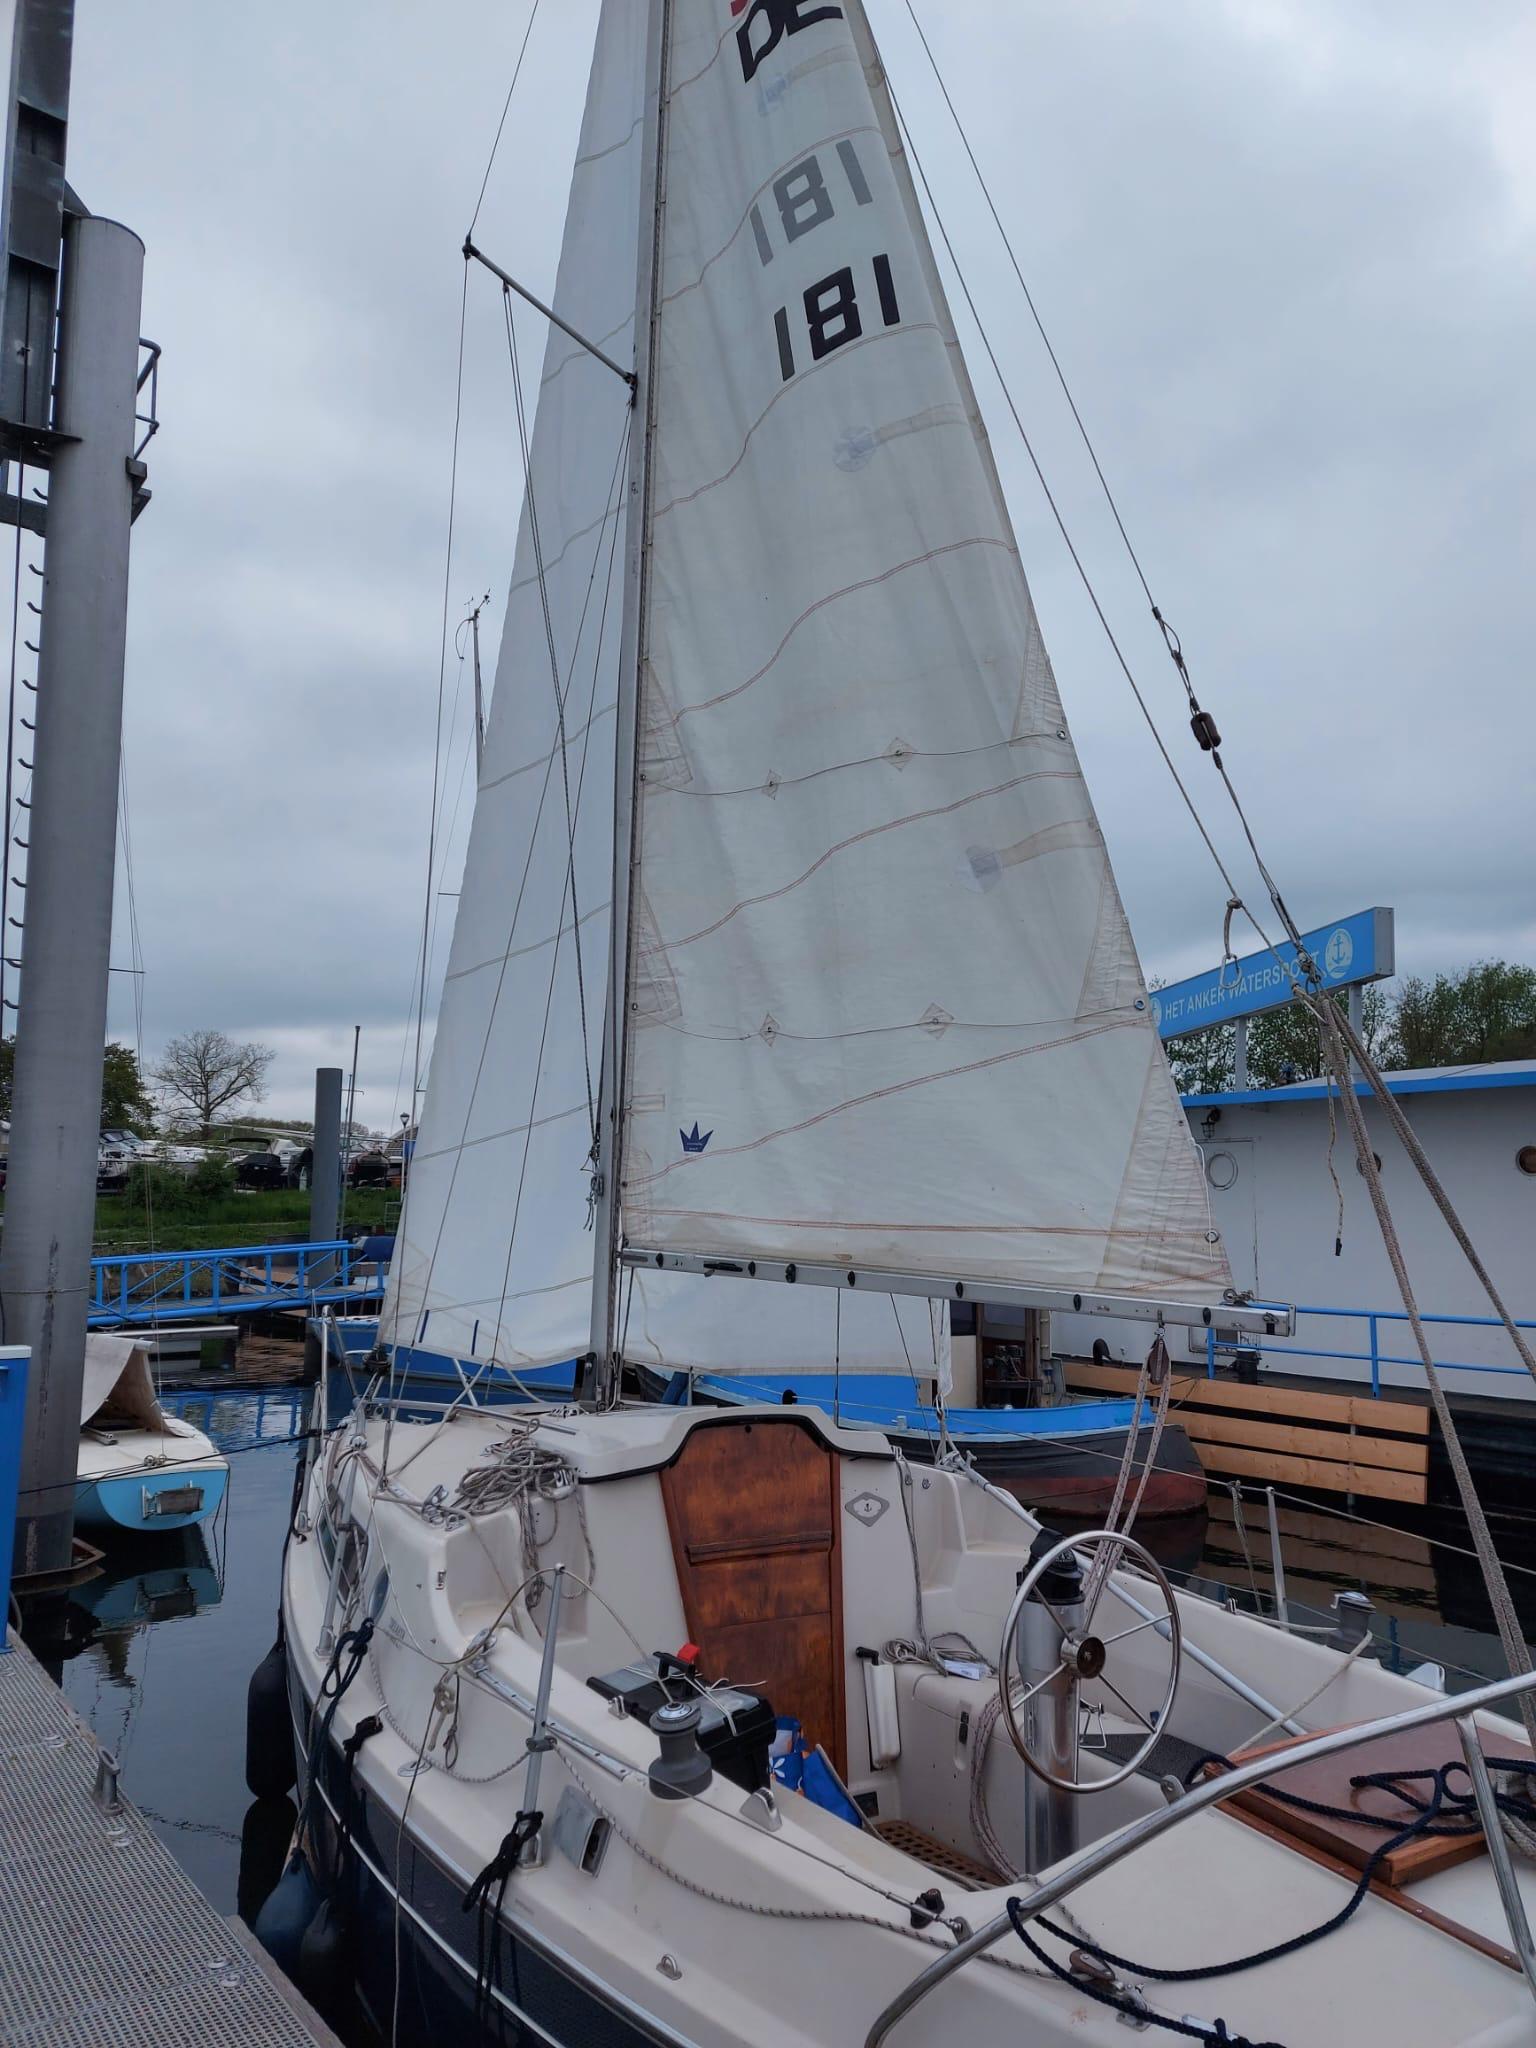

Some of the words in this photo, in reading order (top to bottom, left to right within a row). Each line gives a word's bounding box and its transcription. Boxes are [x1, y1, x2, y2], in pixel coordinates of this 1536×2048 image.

[749, 139, 873, 267] 181
[774, 253, 900, 381] 181
[1165, 998, 1185, 1020] HET
[1187, 986, 1225, 1013] ANKER
[1228, 951, 1320, 999] WATERSPOT
